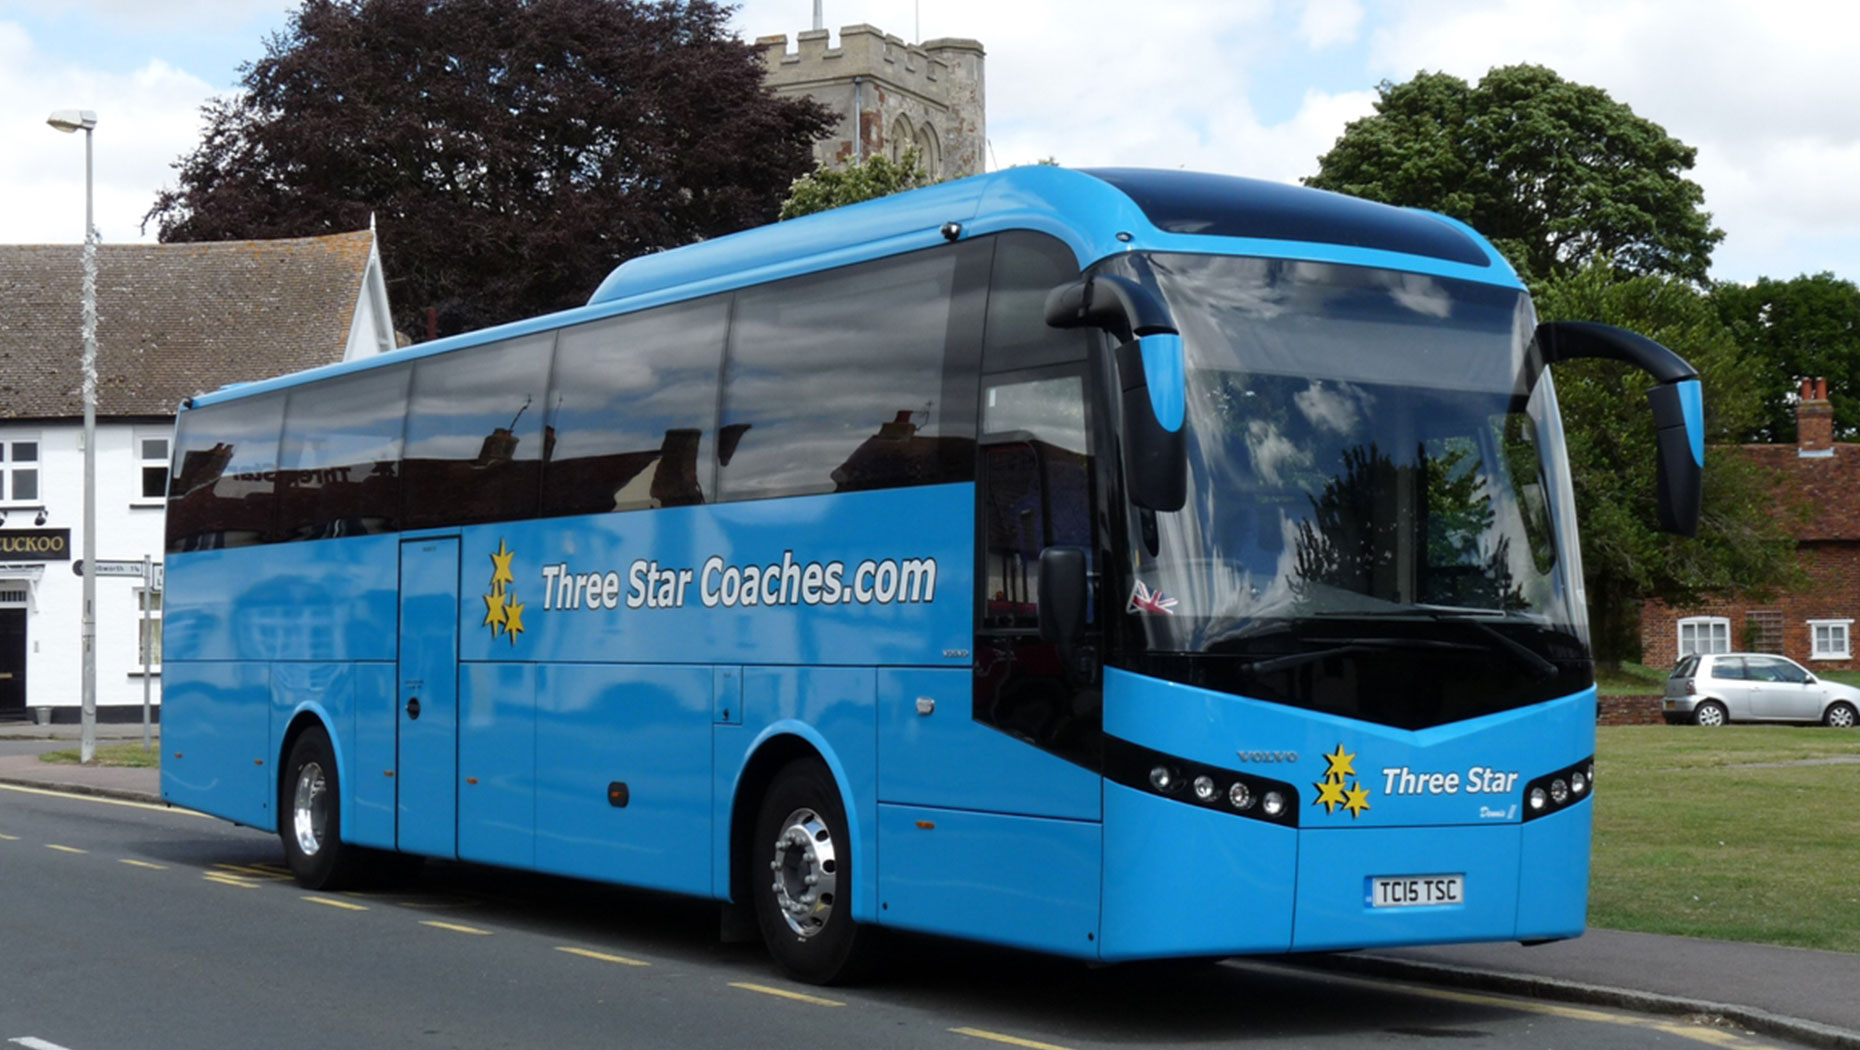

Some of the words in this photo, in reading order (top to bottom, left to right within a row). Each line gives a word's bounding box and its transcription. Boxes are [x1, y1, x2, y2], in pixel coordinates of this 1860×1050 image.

[0, 536, 64, 552] UCKOO
[542, 562, 620, 611] Three
[626, 558, 693, 610] Star
[700, 549, 937, 608] Coaches.com
[1236, 751, 1299, 764] VOLVO
[1382, 767, 1459, 795] Three
[1465, 765, 1519, 794] Star
[1380, 881, 1419, 903] TC15
[1424, 879, 1457, 901] TSC
